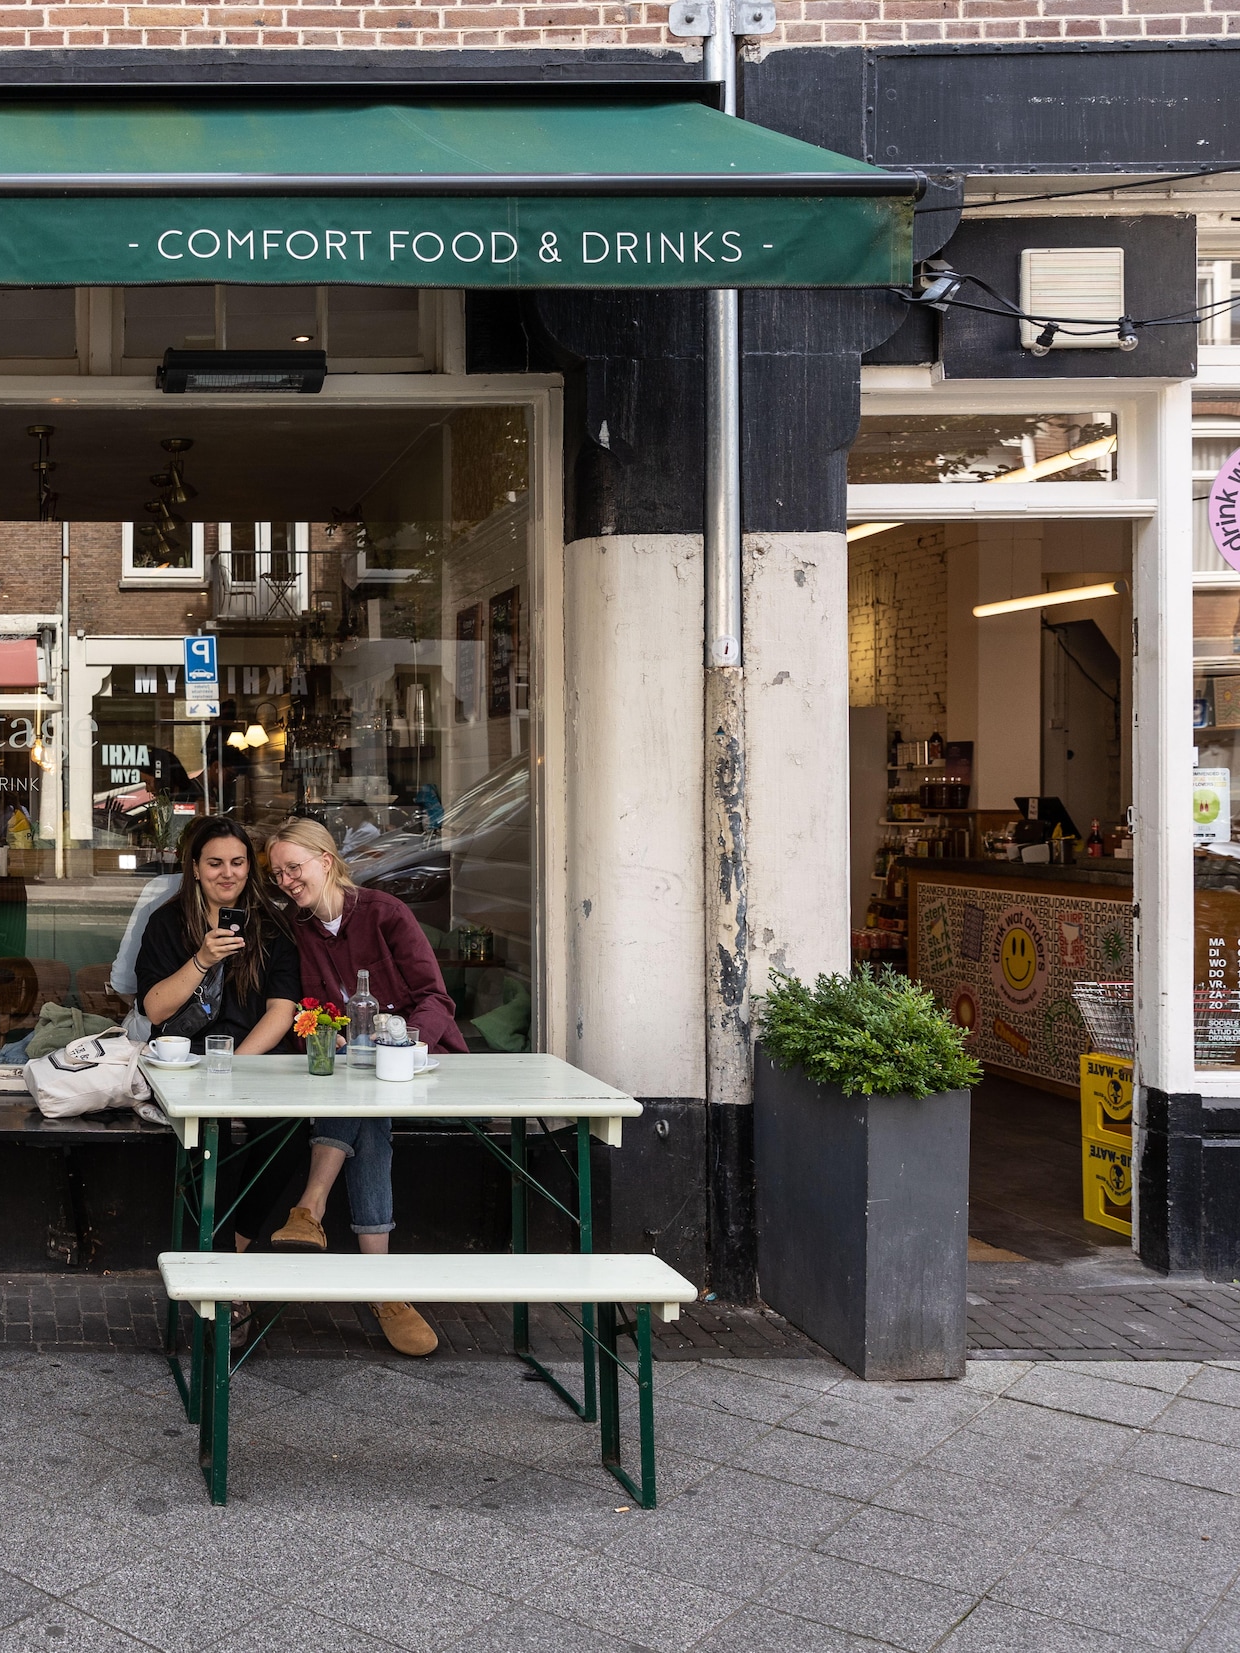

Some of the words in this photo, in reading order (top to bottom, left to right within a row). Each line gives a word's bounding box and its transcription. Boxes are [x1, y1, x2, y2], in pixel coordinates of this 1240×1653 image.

[157, 230, 372, 263] COMFORT
[389, 230, 518, 263] FOOD
[538, 231, 562, 263] &
[582, 231, 742, 264] DRINKS
[991, 923, 1007, 964] drink
[1005, 910, 1024, 928] wat
[1024, 916, 1046, 972] anders
[1208, 938, 1225, 946] MA
[1208, 949, 1219, 957] DI
[1208, 959, 1227, 967] WO
[1208, 970, 1225, 978] DO
